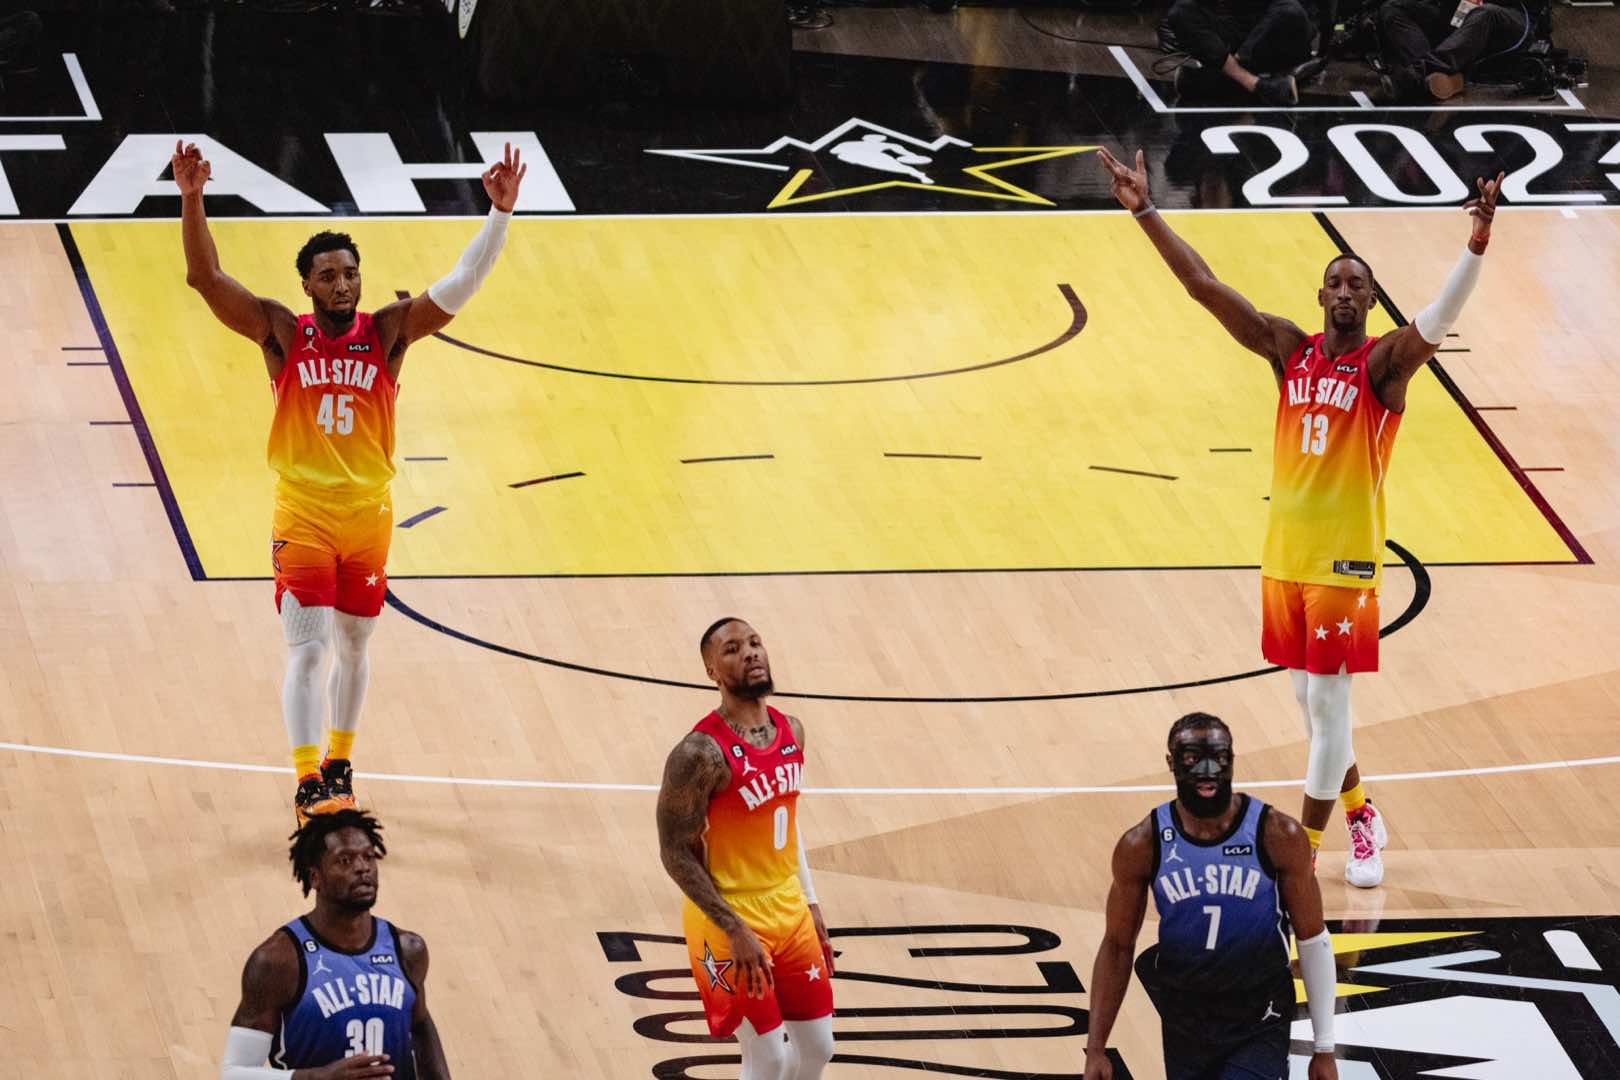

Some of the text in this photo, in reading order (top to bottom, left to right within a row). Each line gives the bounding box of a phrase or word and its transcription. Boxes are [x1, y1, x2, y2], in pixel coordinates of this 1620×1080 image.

[305, 327, 313, 336] 6
[317, 393, 354, 435] 45
[1301, 413, 1328, 456] 13
[732, 745, 743, 757] 6
[773, 806, 788, 849] 0
[1164, 828, 1173, 841] 6
[1225, 846, 1250, 854] KIA
[1203, 905, 1221, 950] 7
[305, 941, 317, 952] 6
[372, 955, 392, 963] KIA
[345, 1017, 384, 1066] 30
